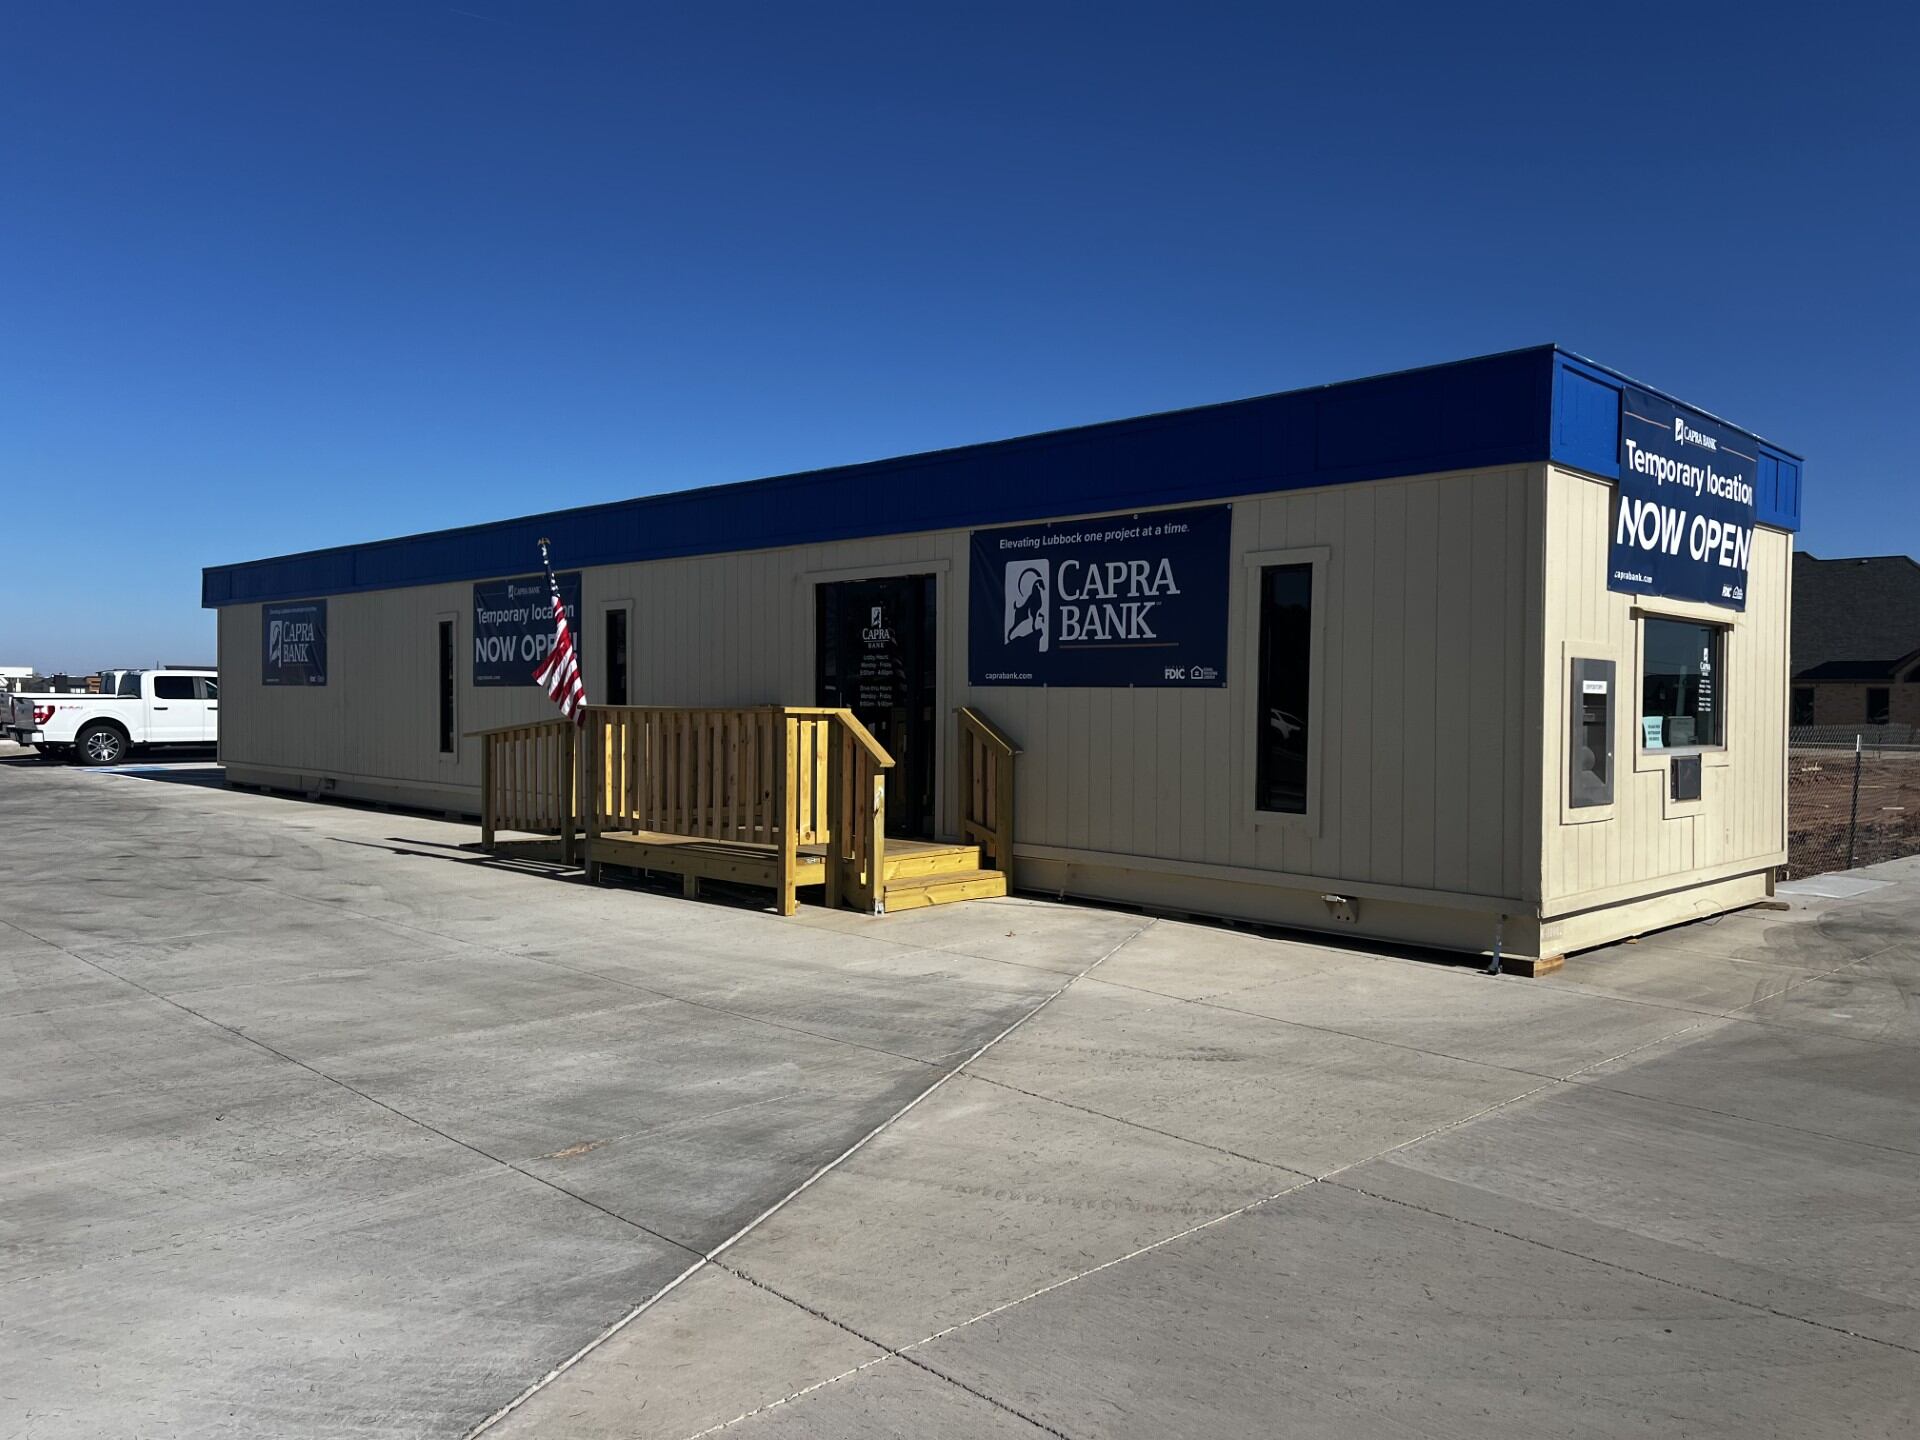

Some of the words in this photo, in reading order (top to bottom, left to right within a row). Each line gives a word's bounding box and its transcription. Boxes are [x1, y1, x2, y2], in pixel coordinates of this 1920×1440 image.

[1684, 426, 1702, 445] CAPRA
[1703, 434, 1717, 450] BANK
[1626, 439, 1704, 496] Temporary
[1707, 465, 1753, 506] location
[1000, 537, 1040, 549] Elevating
[1042, 532, 1082, 546] Lubbock
[1084, 532, 1102, 542] one
[1105, 528, 1140, 542] project
[1142, 525, 1152, 536] at
[1154, 527, 1161, 535] a
[1164, 523, 1190, 534] time.
[1617, 496, 1686, 555] NOW
[1690, 515, 1751, 570] OPEN
[1058, 558, 1180, 601] CAPRA
[477, 608, 529, 627] Temporary
[1059, 602, 1156, 641] BANK
[283, 621, 314, 642] CAPRA
[862, 628, 890, 640] CAPRA
[283, 643, 309, 662] BANK
[475, 635, 517, 662] NOW
[985, 672, 1032, 680] caprabank.com
[1164, 668, 1185, 679] FDIC
